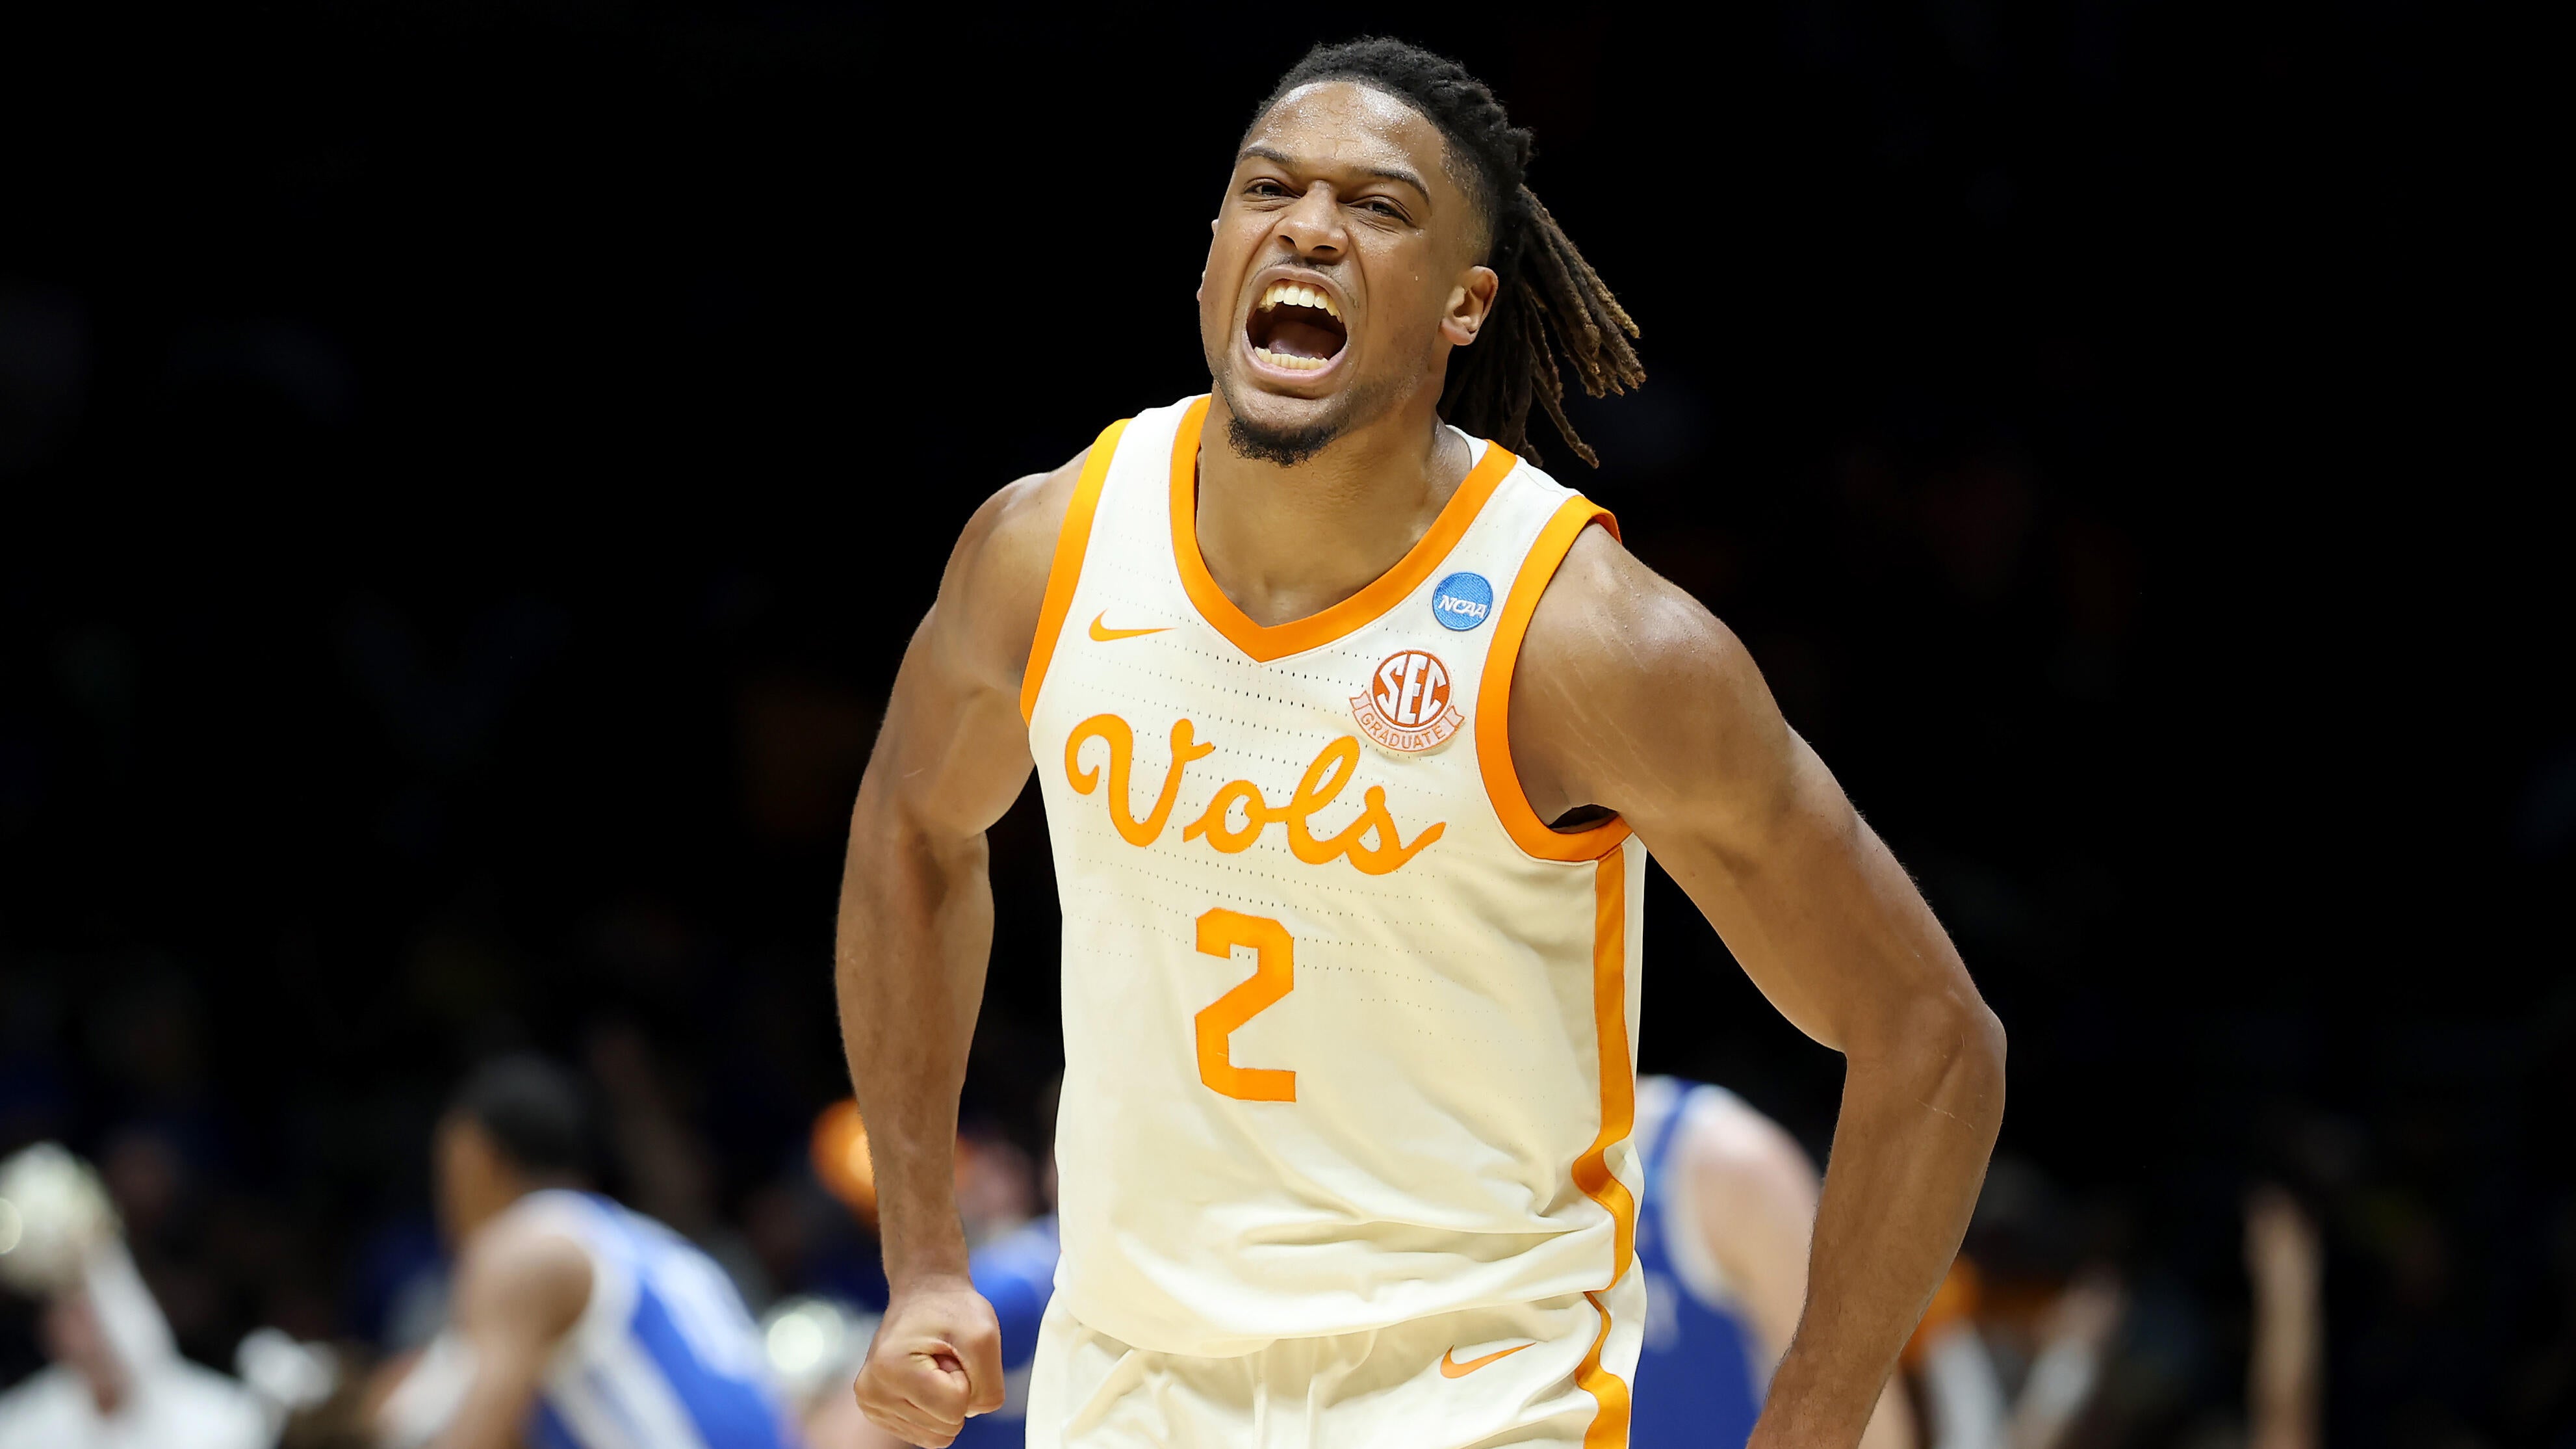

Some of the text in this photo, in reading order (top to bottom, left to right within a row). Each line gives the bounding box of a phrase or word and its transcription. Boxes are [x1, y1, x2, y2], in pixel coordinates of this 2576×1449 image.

[1438, 594, 1488, 619] NCAA
[1376, 653, 1447, 725] SEC
[1360, 712, 1446, 749] GRADUATE
[1064, 713, 1447, 876] Vols
[1194, 907, 1296, 1103] 2
